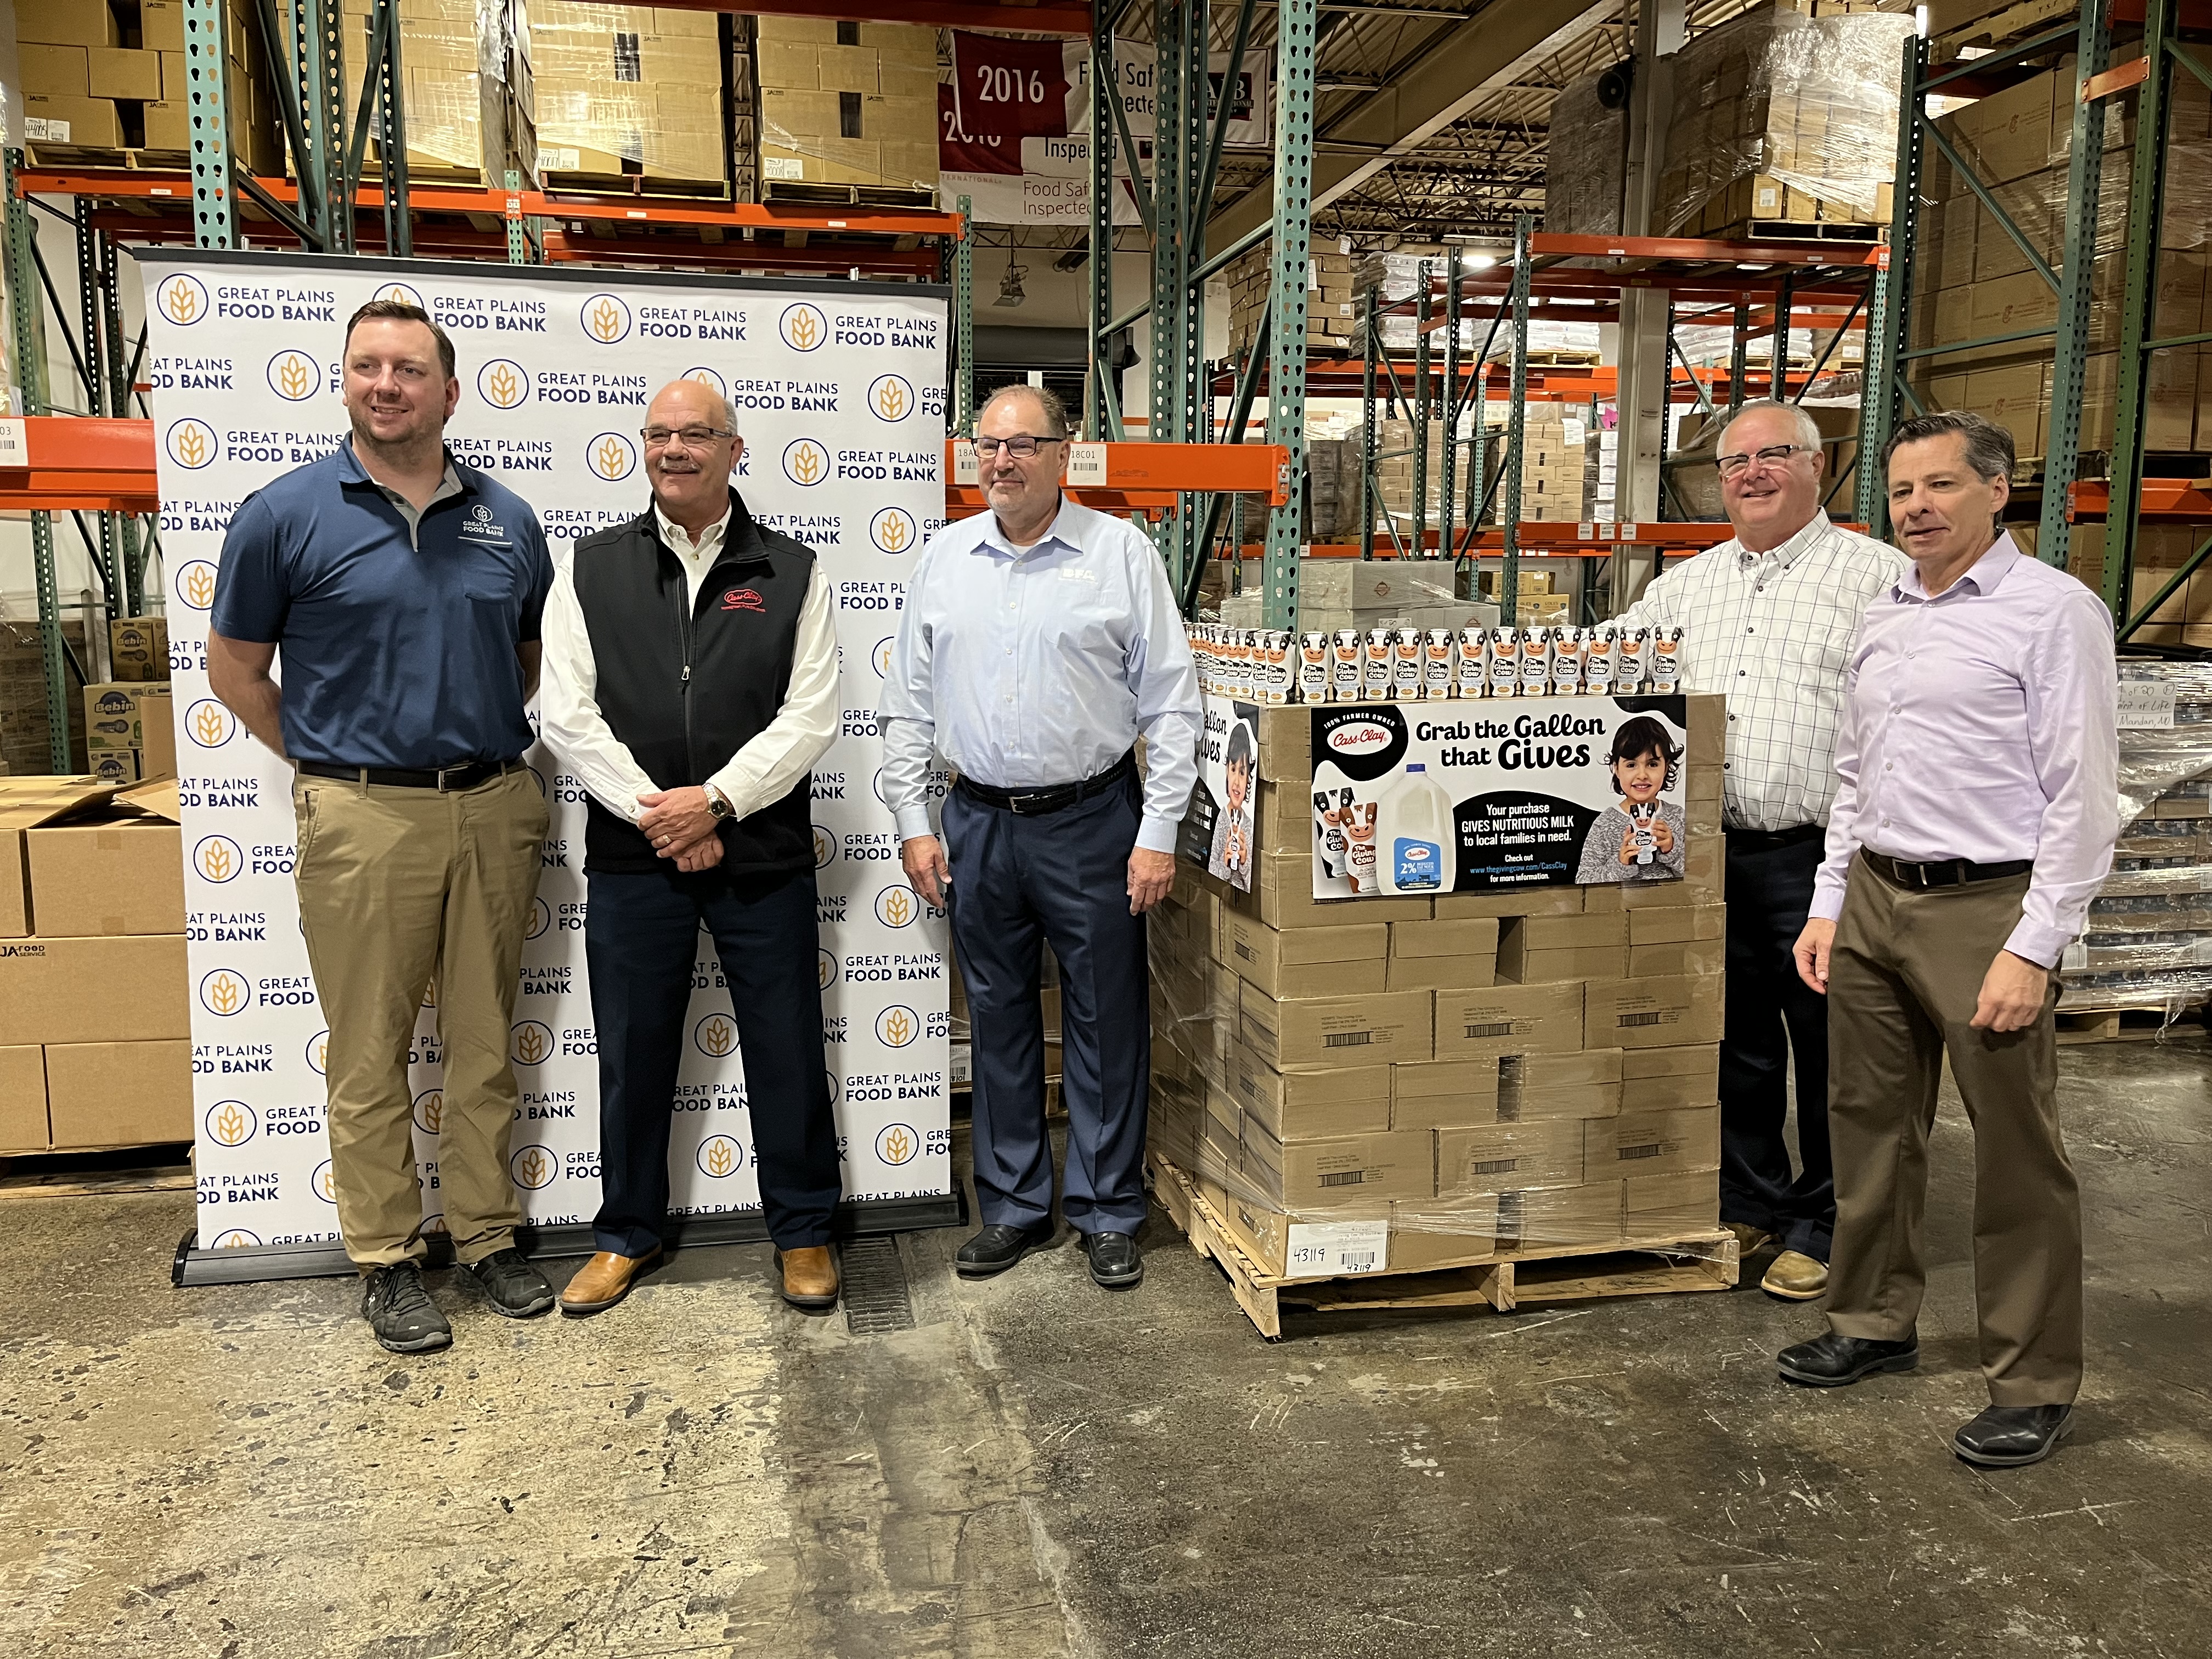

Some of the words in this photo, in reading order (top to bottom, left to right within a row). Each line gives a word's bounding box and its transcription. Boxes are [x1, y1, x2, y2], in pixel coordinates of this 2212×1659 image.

[978, 65, 1044, 103] 2016
[1024, 181, 1060, 196] Food
[218, 287, 269, 300] GREAT
[277, 290, 334, 303] PLAINS
[218, 303, 274, 318] FOOD
[283, 306, 335, 321] BANK
[434, 297, 483, 311] GREAT
[490, 300, 545, 313] PLAINS
[640, 308, 687, 320] GREAT
[695, 310, 746, 322] PLAINS
[496, 317, 546, 332] BANK
[836, 316, 881, 328] GREAT
[888, 318, 936, 331] PLAINS
[640, 323, 691, 337] FOOD
[699, 325, 746, 340] BANK
[836, 331, 884, 345] FOOD
[892, 334, 936, 349] BANK
[176, 358, 232, 370] PLAINS
[181, 375, 233, 389] BANK
[538, 373, 586, 385] GREAT
[593, 375, 646, 387] PLAINS
[735, 380, 781, 392] GREAT
[788, 382, 838, 394] PLAINS
[538, 388, 590, 403] FOOD
[598, 391, 646, 405] BANK
[735, 395, 785, 409] FOOD
[792, 397, 838, 411] BANK
[227, 431, 278, 443] GREAT
[228, 447, 283, 461] FOOD
[498, 441, 551, 453] PLAINS
[503, 456, 552, 470] BANK
[838, 451, 883, 462] GREAT
[889, 452, 936, 464] PLAINS
[838, 466, 886, 479] FOOD
[894, 467, 936, 481] BANK
[483, 523, 504, 531] PLAINS
[791, 516, 840, 527] PLAINS
[486, 528, 504, 537] BANK
[794, 531, 840, 544] BANK
[841, 583, 884, 592] GREAT
[841, 597, 888, 610] FOOD
[1324, 717, 1340, 729] 100%
[1373, 714, 1395, 727] OWNED
[1417, 721, 1470, 741] Grab
[1475, 720, 1510, 738] the
[1514, 713, 1606, 738] Gallon
[1441, 747, 1492, 766] that
[1498, 738, 1590, 770] Gives
[204, 779, 257, 789] PLAINS
[208, 794, 258, 807] BANK
[1486, 804, 1506, 816] Your
[1509, 803, 1549, 818] purchase
[1462, 820, 1490, 833] GIVES
[1493, 817, 1548, 831] NUTRITIOUS
[1551, 816, 1574, 828] MILK
[845, 834, 888, 844] GREAT
[1464, 836, 1474, 846] to
[1476, 833, 1498, 846] local
[1500, 832, 1535, 844] families
[1538, 832, 1545, 842] in
[1548, 830, 1571, 842] need.
[845, 848, 891, 860] FOOD
[1505, 854, 1523, 862] Check
[1400, 863, 1417, 874] 2%
[1470, 861, 1567, 874] www.thegivingcow.com/CassClay
[846, 956, 888, 966] GREAT
[895, 953, 940, 964] PLAINS
[519, 967, 572, 979] PLAINS
[846, 969, 891, 981] FOOD
[899, 967, 940, 980] BANK
[259, 977, 309, 989] GREAT
[524, 981, 571, 995] BANK
[260, 992, 314, 1006] FOOD
[217, 1045, 272, 1056] PLAINS
[222, 1059, 273, 1073] BANK
[847, 1075, 889, 1086] GREAT
[895, 1072, 940, 1084] PLAINS
[847, 1088, 891, 1102] FOOD
[899, 1085, 940, 1098] BANK
[267, 1107, 315, 1119] GREAT
[267, 1121, 320, 1136] FOOD
[1294, 1248, 1325, 1262] 43119
[1347, 1264, 1371, 1272] 43119
